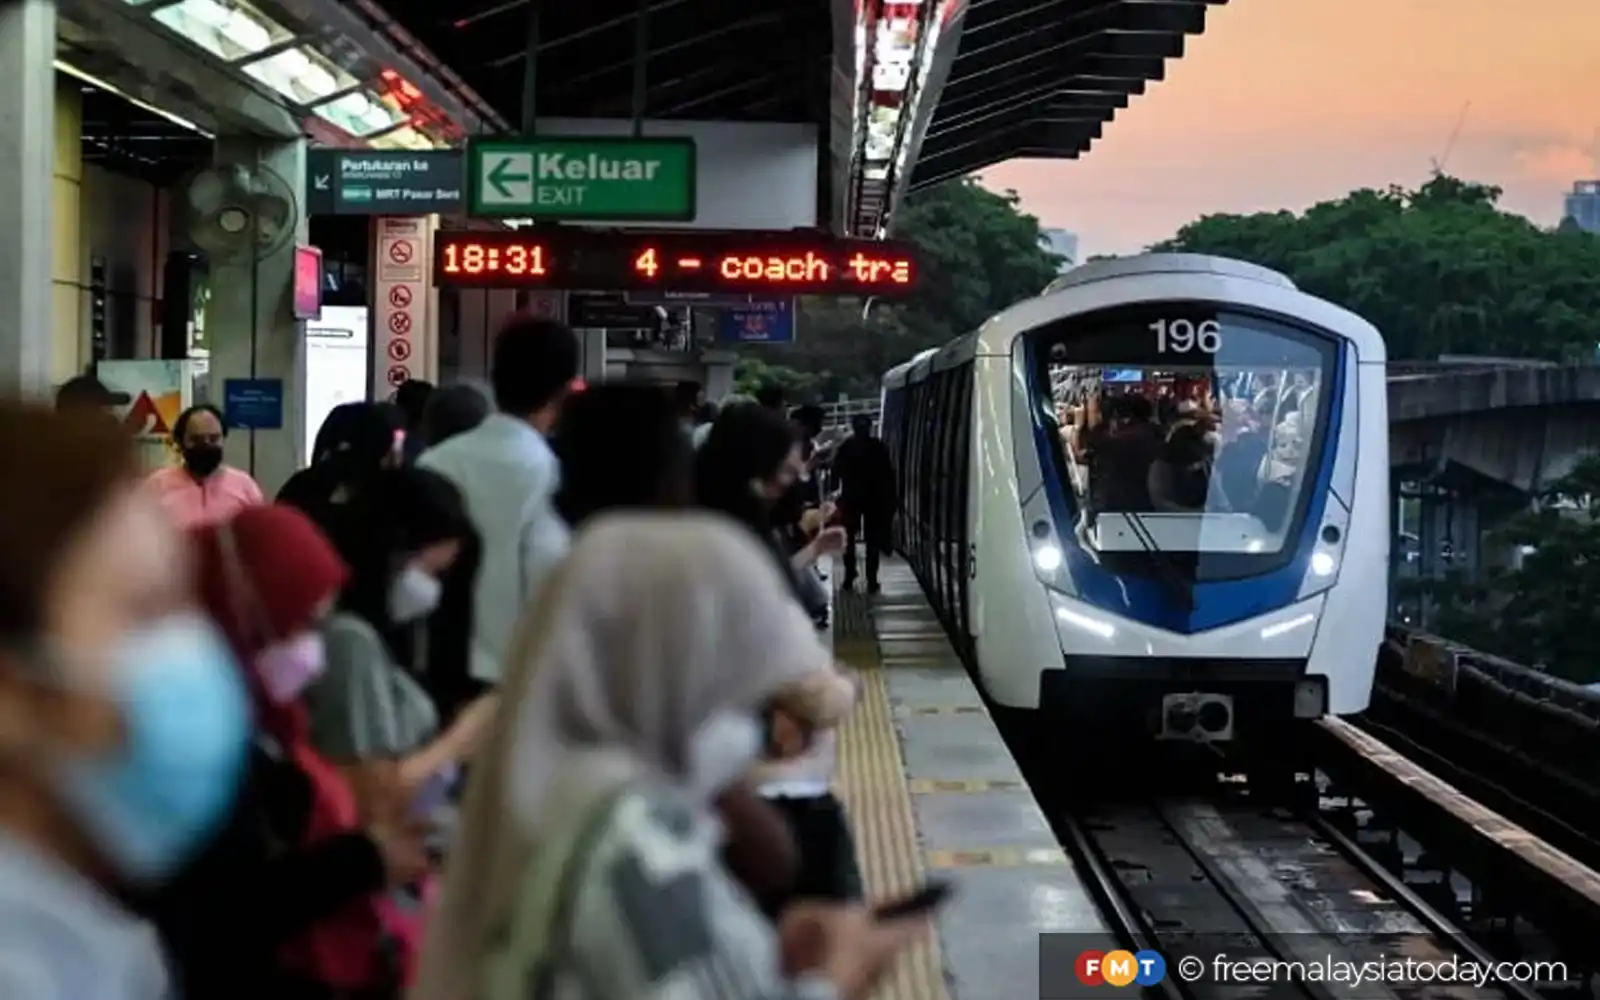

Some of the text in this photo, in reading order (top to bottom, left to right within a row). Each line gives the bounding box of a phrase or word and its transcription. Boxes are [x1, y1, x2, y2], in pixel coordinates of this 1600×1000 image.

[537, 152, 661, 181] Keluar
[537, 185, 587, 206] EXIT
[444, 245, 545, 276] 18:31
[635, 248, 657, 277] 4
[720, 251, 828, 281] coach
[1148, 319, 1222, 353] 196
